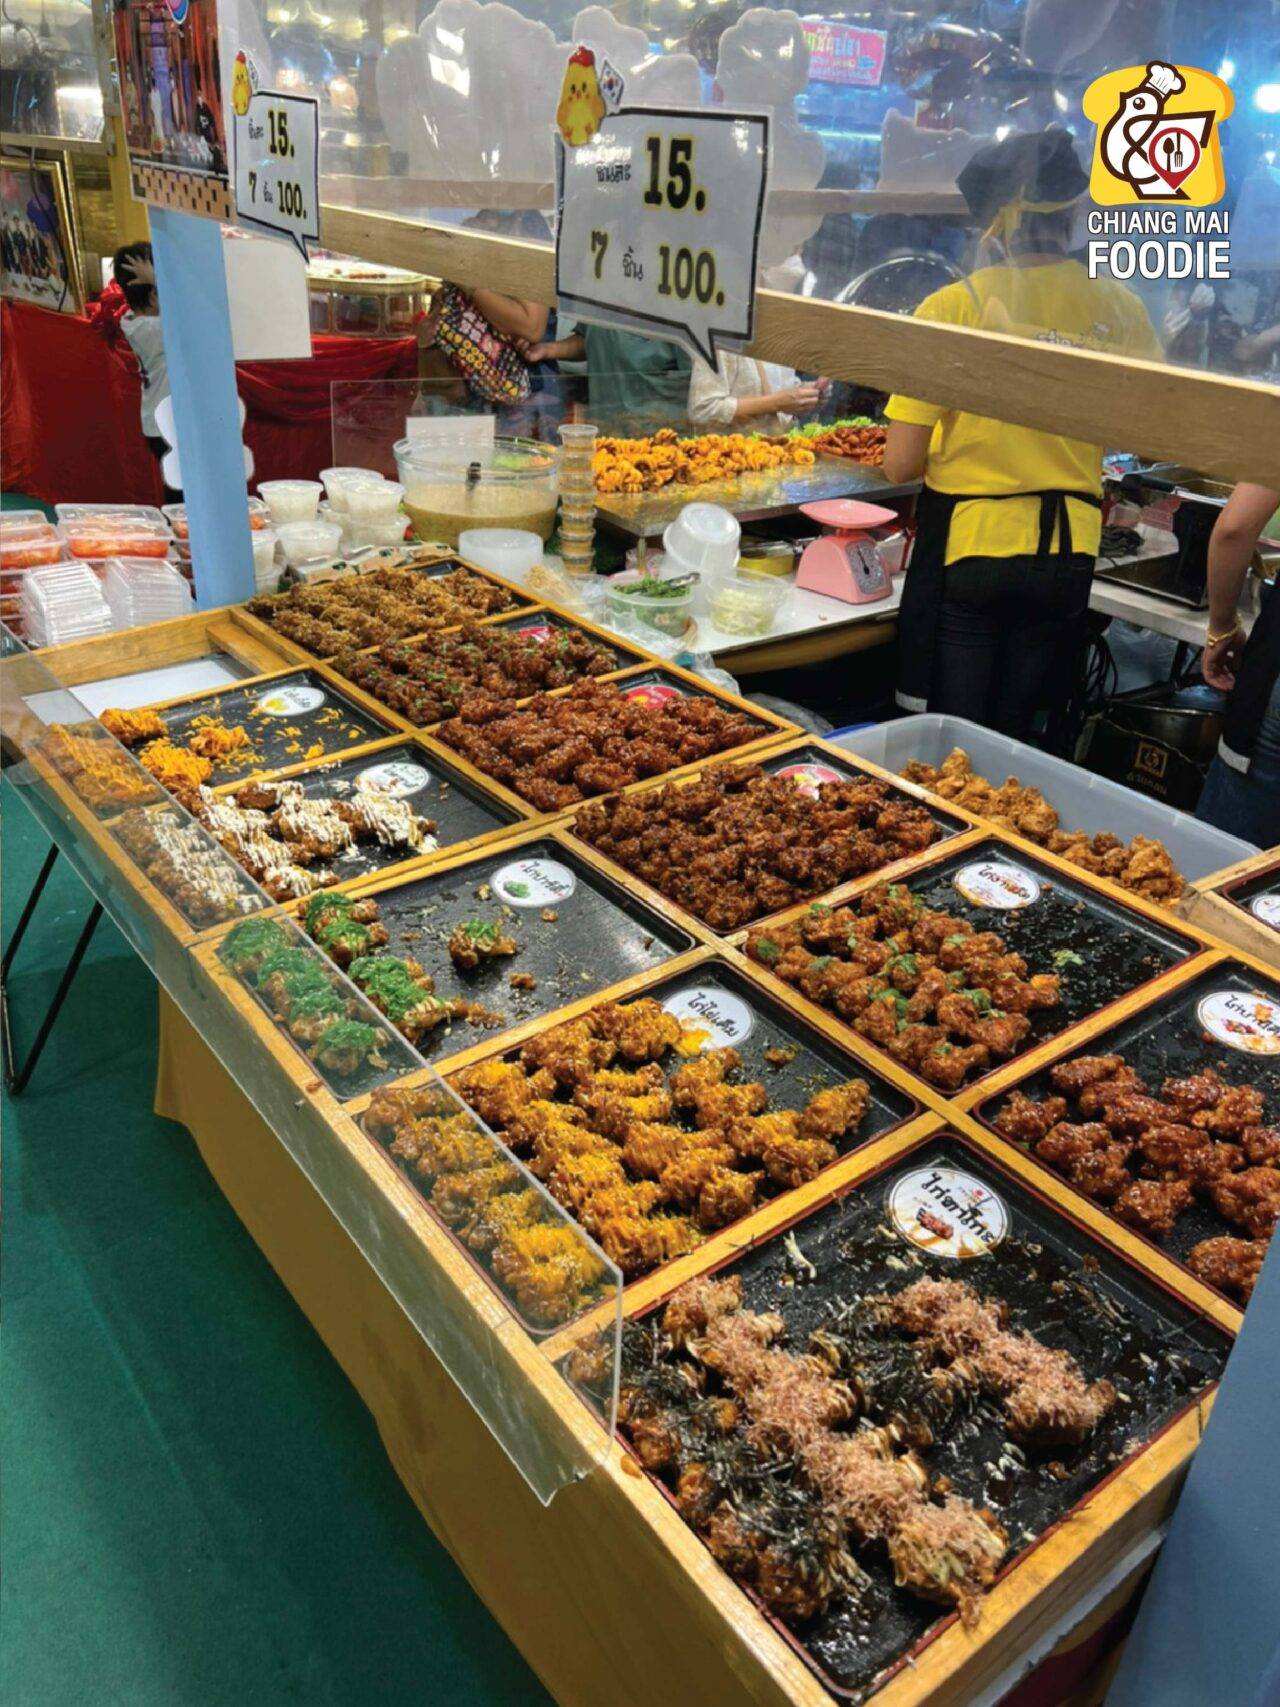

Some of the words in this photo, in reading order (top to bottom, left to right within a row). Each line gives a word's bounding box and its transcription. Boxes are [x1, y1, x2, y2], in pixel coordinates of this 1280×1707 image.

[267, 110, 295, 158] 15.
[248, 171, 257, 204] 7
[277, 180, 307, 219] 100.
[644, 137, 706, 211] 15.
[591, 230, 608, 279] 7
[622, 246, 644, 281] ชิ้น
[658, 245, 725, 306] 100.
